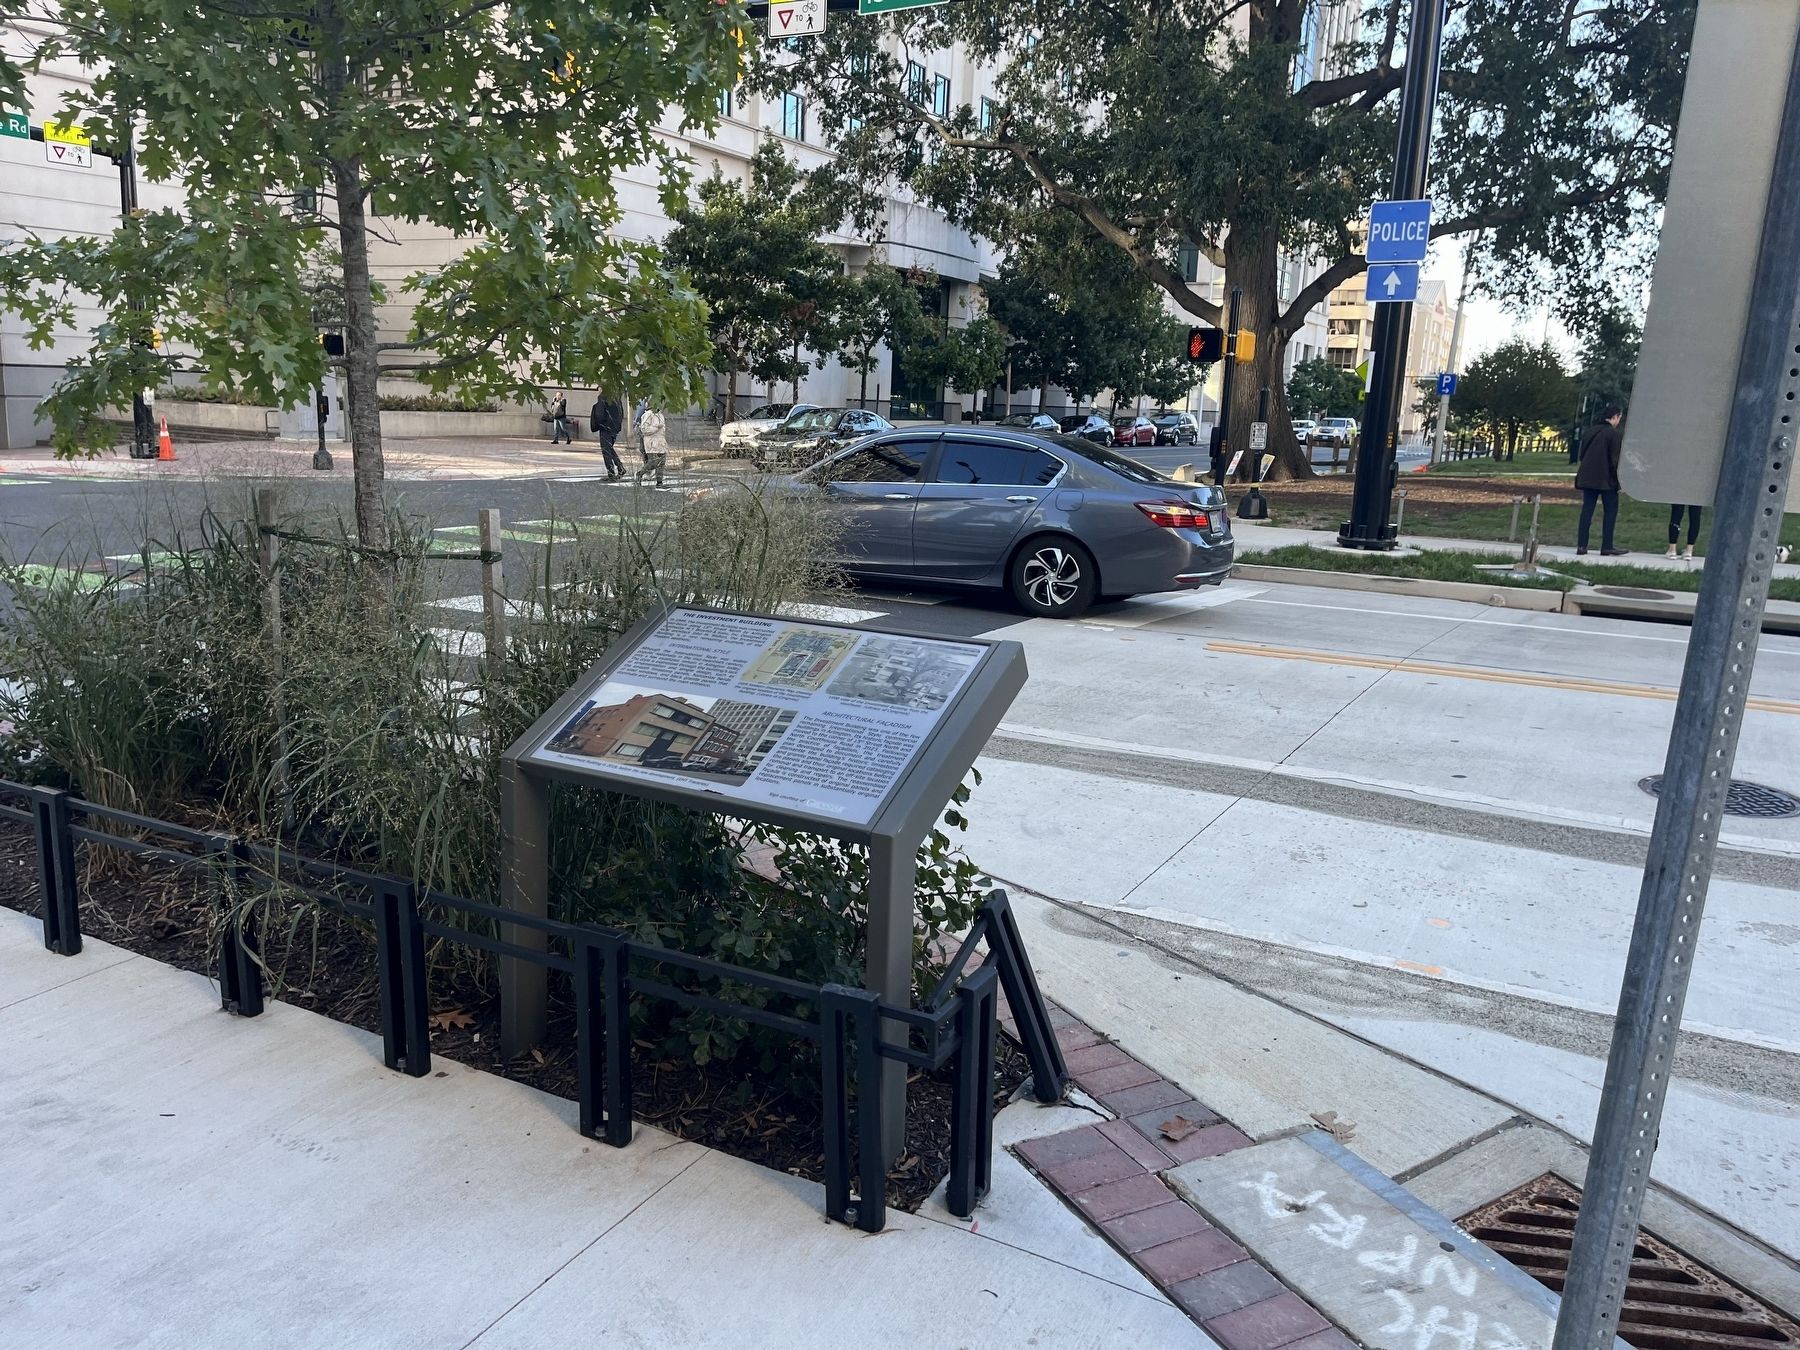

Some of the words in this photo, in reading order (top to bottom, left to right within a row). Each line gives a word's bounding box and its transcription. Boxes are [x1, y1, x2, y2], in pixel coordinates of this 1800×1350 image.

[795, 14, 804, 22] TO
[9, 119, 27, 133] Rd
[1371, 221, 1426, 242] POLICE
[1442, 375, 1452, 388] P
[696, 614, 737, 623] INVESTMENT
[738, 619, 773, 627] BUILDING
[668, 643, 712, 652] INTERNATIONAL
[821, 711, 874, 724] ARCHITECTURAL
[876, 719, 912, 730] FAÇADISM
